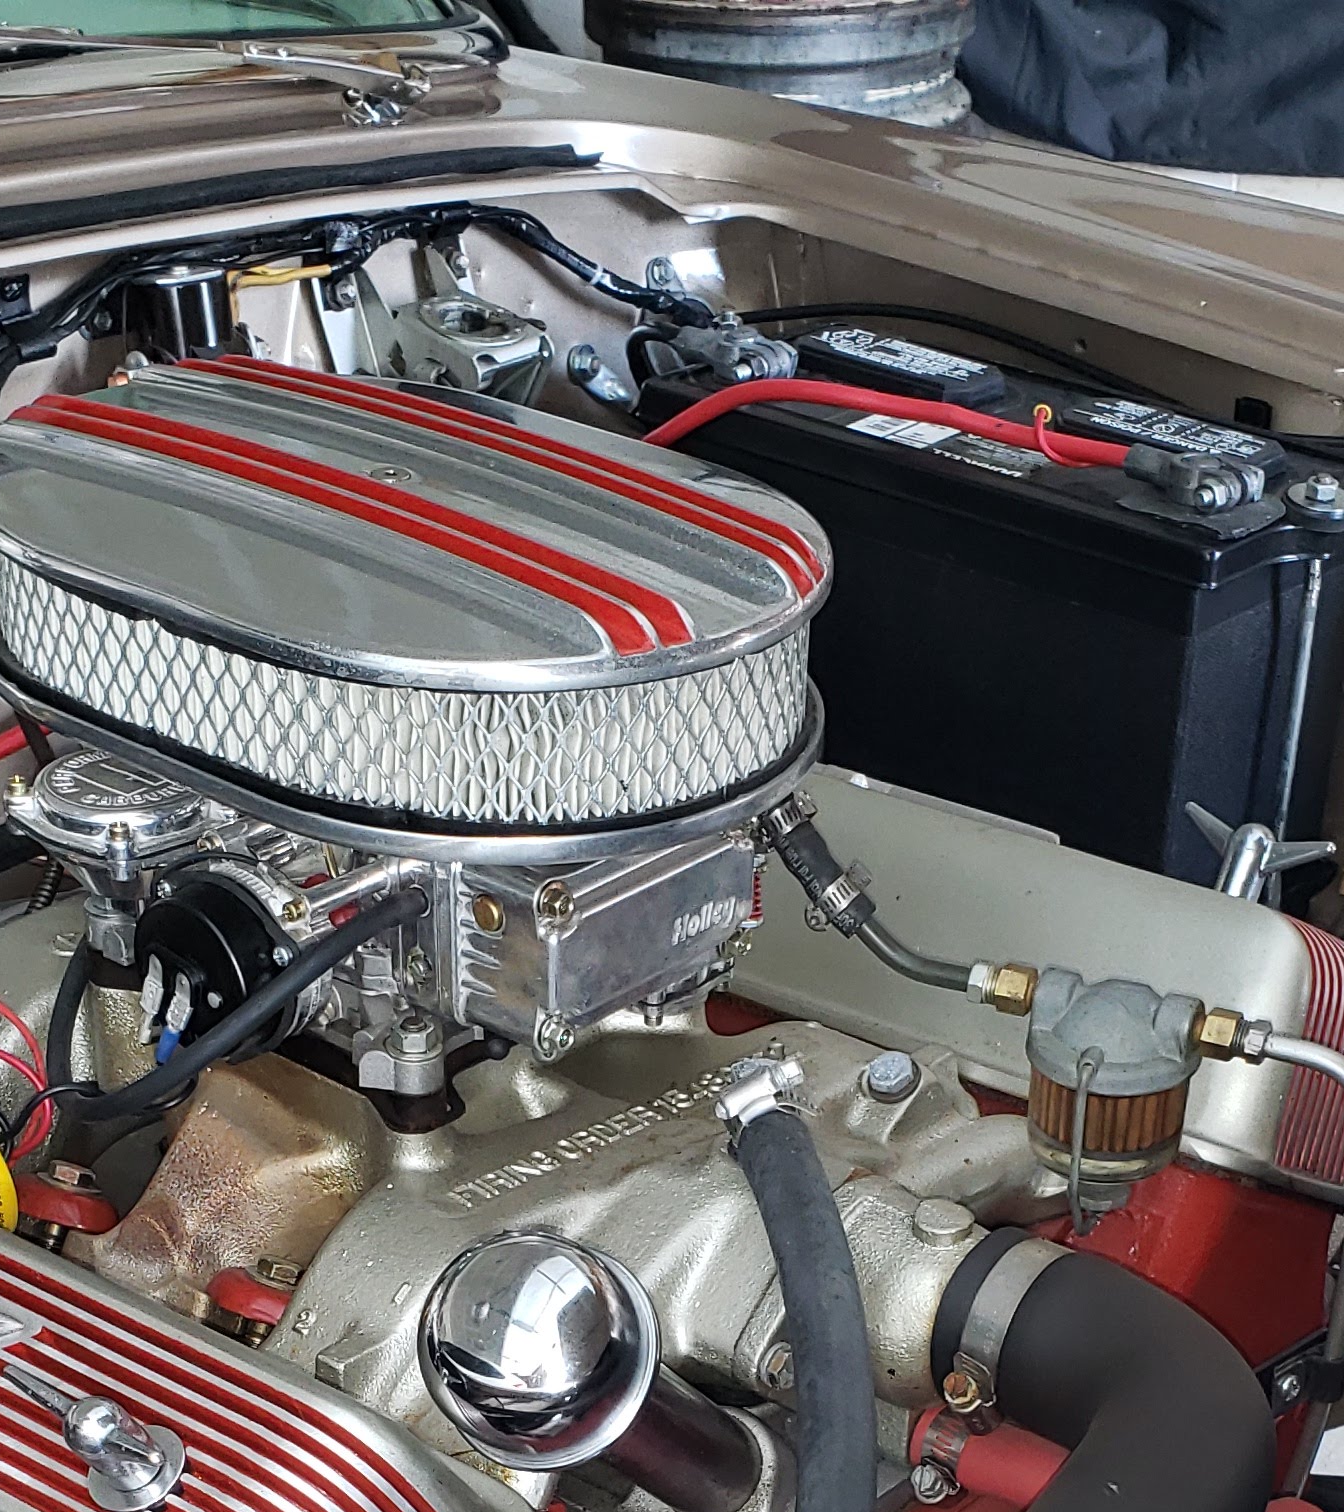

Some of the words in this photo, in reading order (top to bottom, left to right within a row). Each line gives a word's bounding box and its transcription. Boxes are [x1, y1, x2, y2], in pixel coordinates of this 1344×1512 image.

[671, 896, 737, 947] Holley
[446, 1150, 562, 1208] FIRING
[556, 1105, 664, 1160] ORDER
